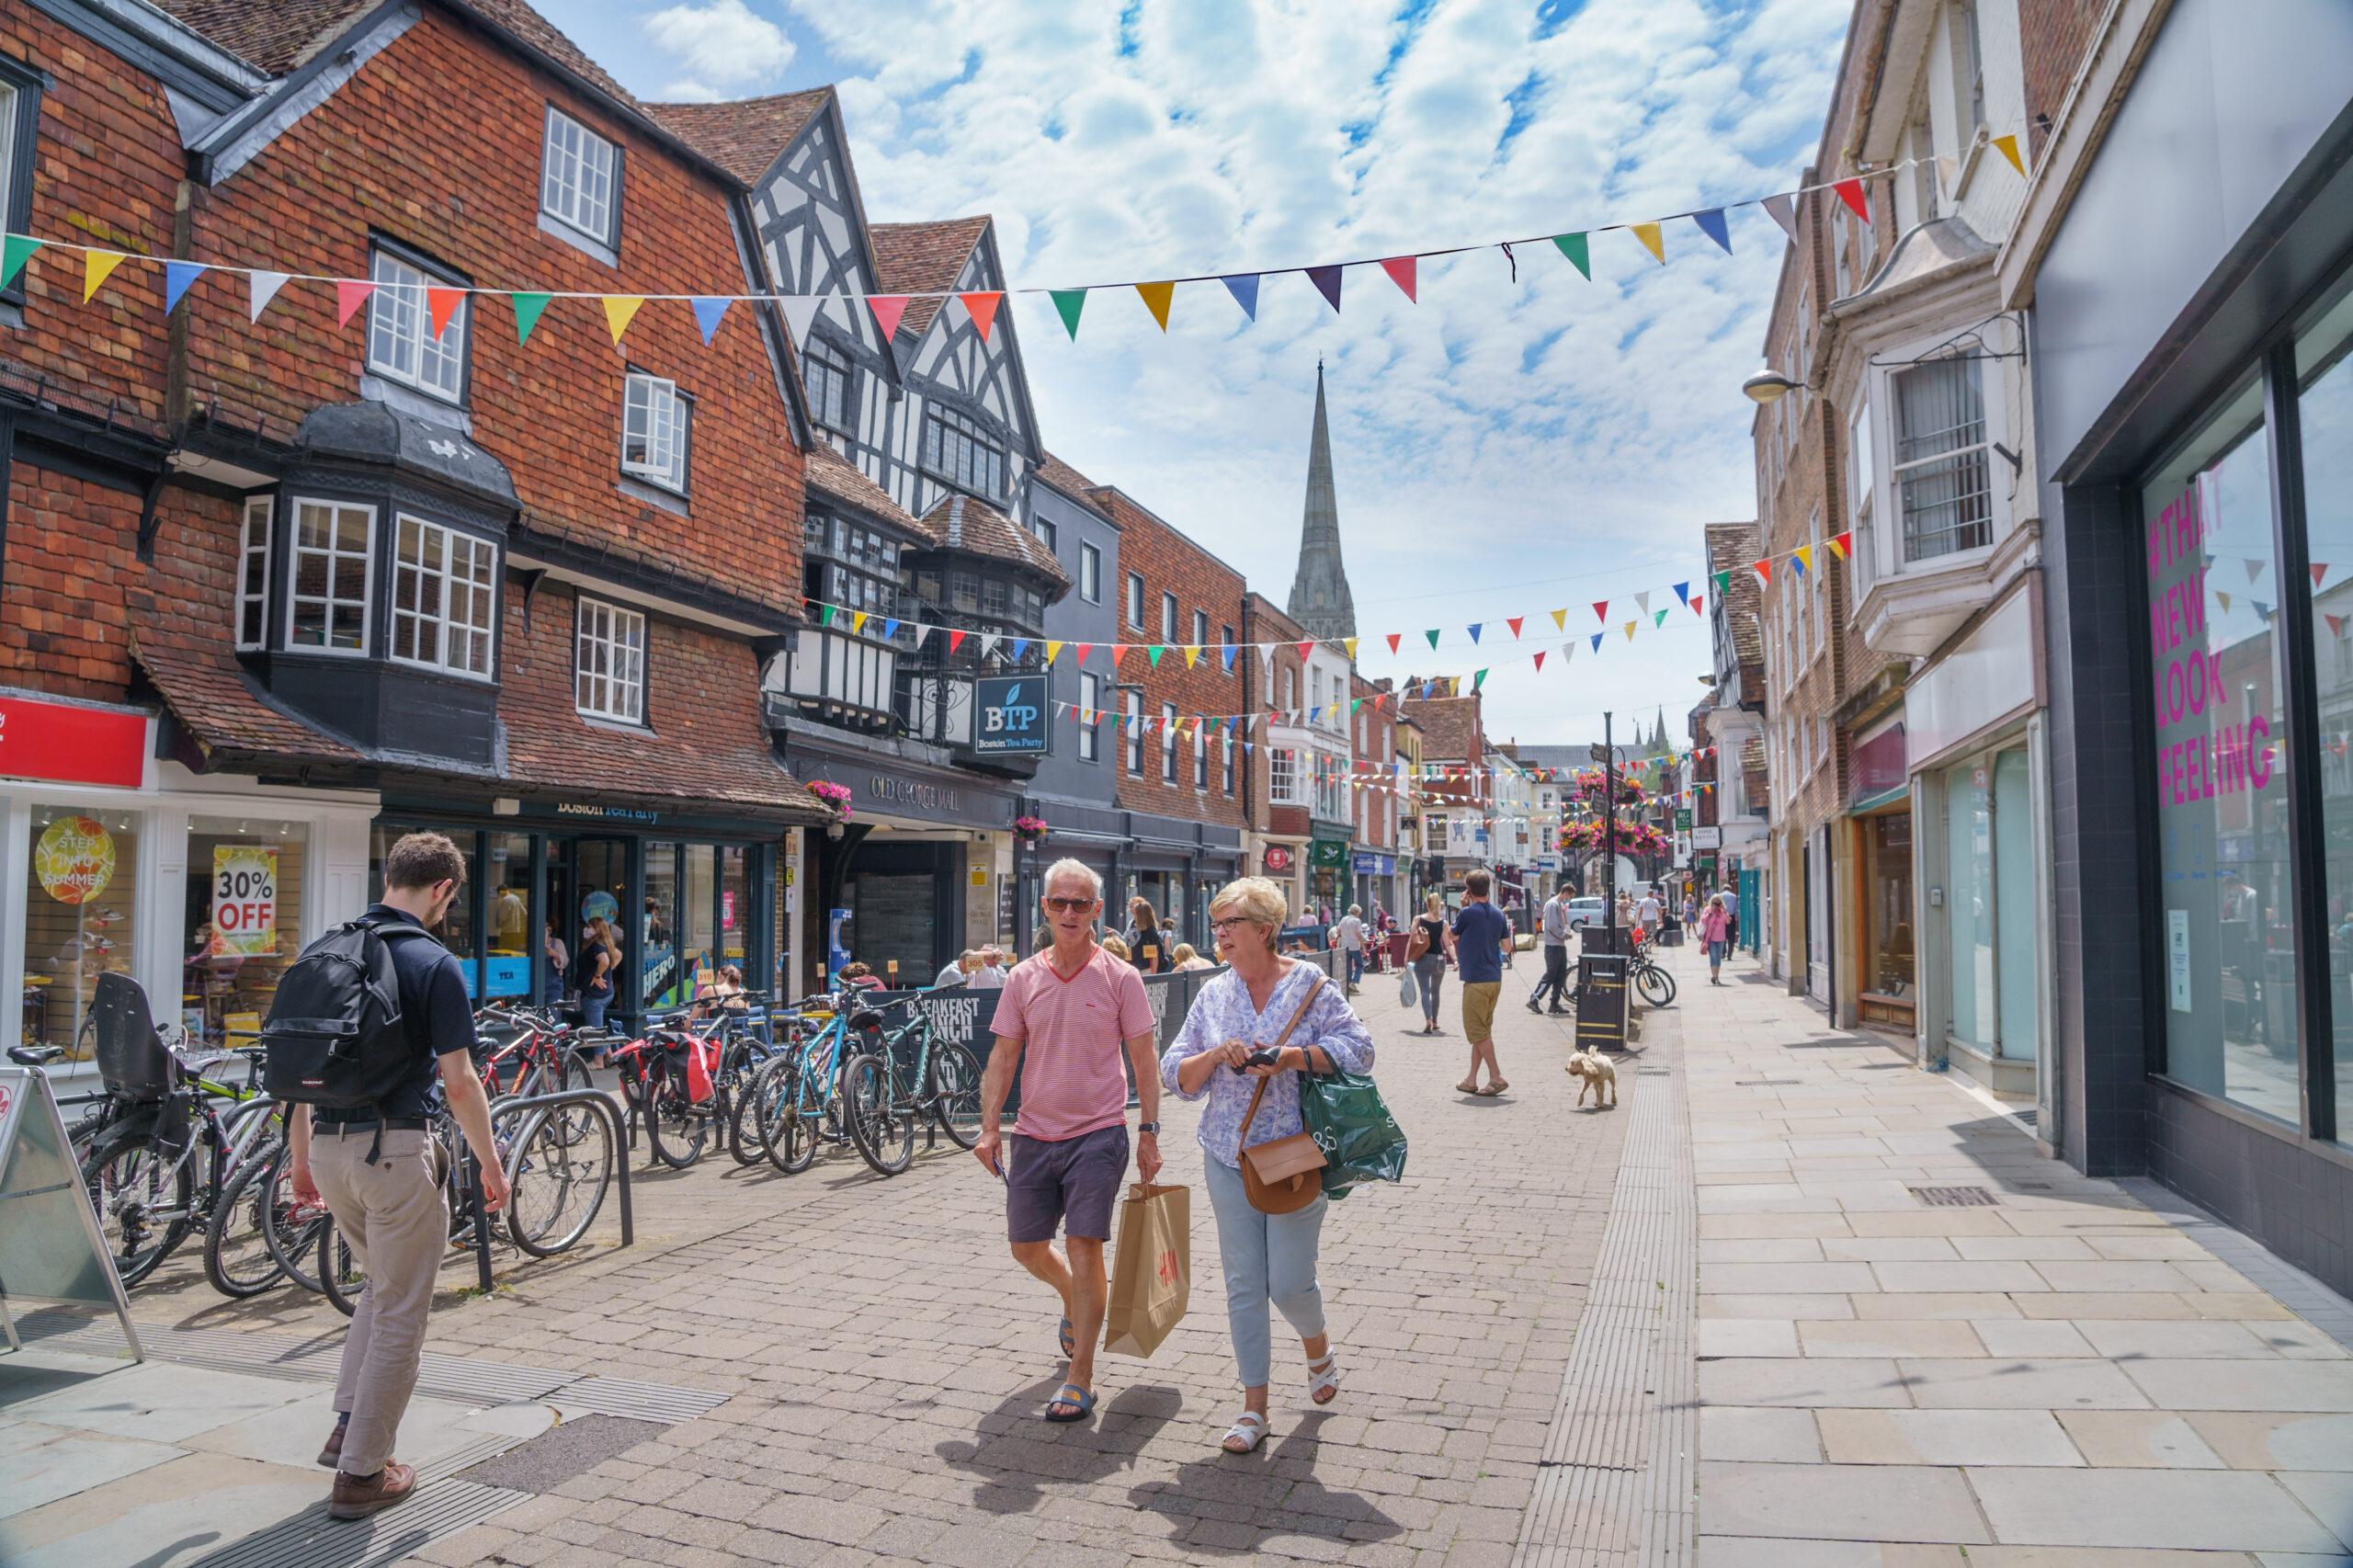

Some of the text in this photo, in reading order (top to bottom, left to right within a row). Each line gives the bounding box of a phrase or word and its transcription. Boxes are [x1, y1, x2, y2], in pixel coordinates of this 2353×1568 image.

[2148, 459, 2223, 581] #THAT
[2151, 565, 2205, 660] NEW
[2155, 638, 2227, 730] LOOK
[985, 706, 1038, 732] BTP
[979, 738, 1043, 749] Boston Tea Party
[2160, 715, 2272, 809] FEELING
[871, 775, 960, 811] OLD GEORGE MALL
[59, 836, 96, 848] STEP
[58, 853, 94, 868] INTO
[43, 872, 106, 885] SUMMER
[218, 870, 273, 899] 30%
[218, 903, 272, 931] OFF
[643, 955, 676, 999] HERO
[968, 960, 983, 968] 305
[906, 997, 980, 1019] BEAKFAST
[1313, 1125, 1337, 1154] &S
[1159, 1247, 1178, 1288] H&M
